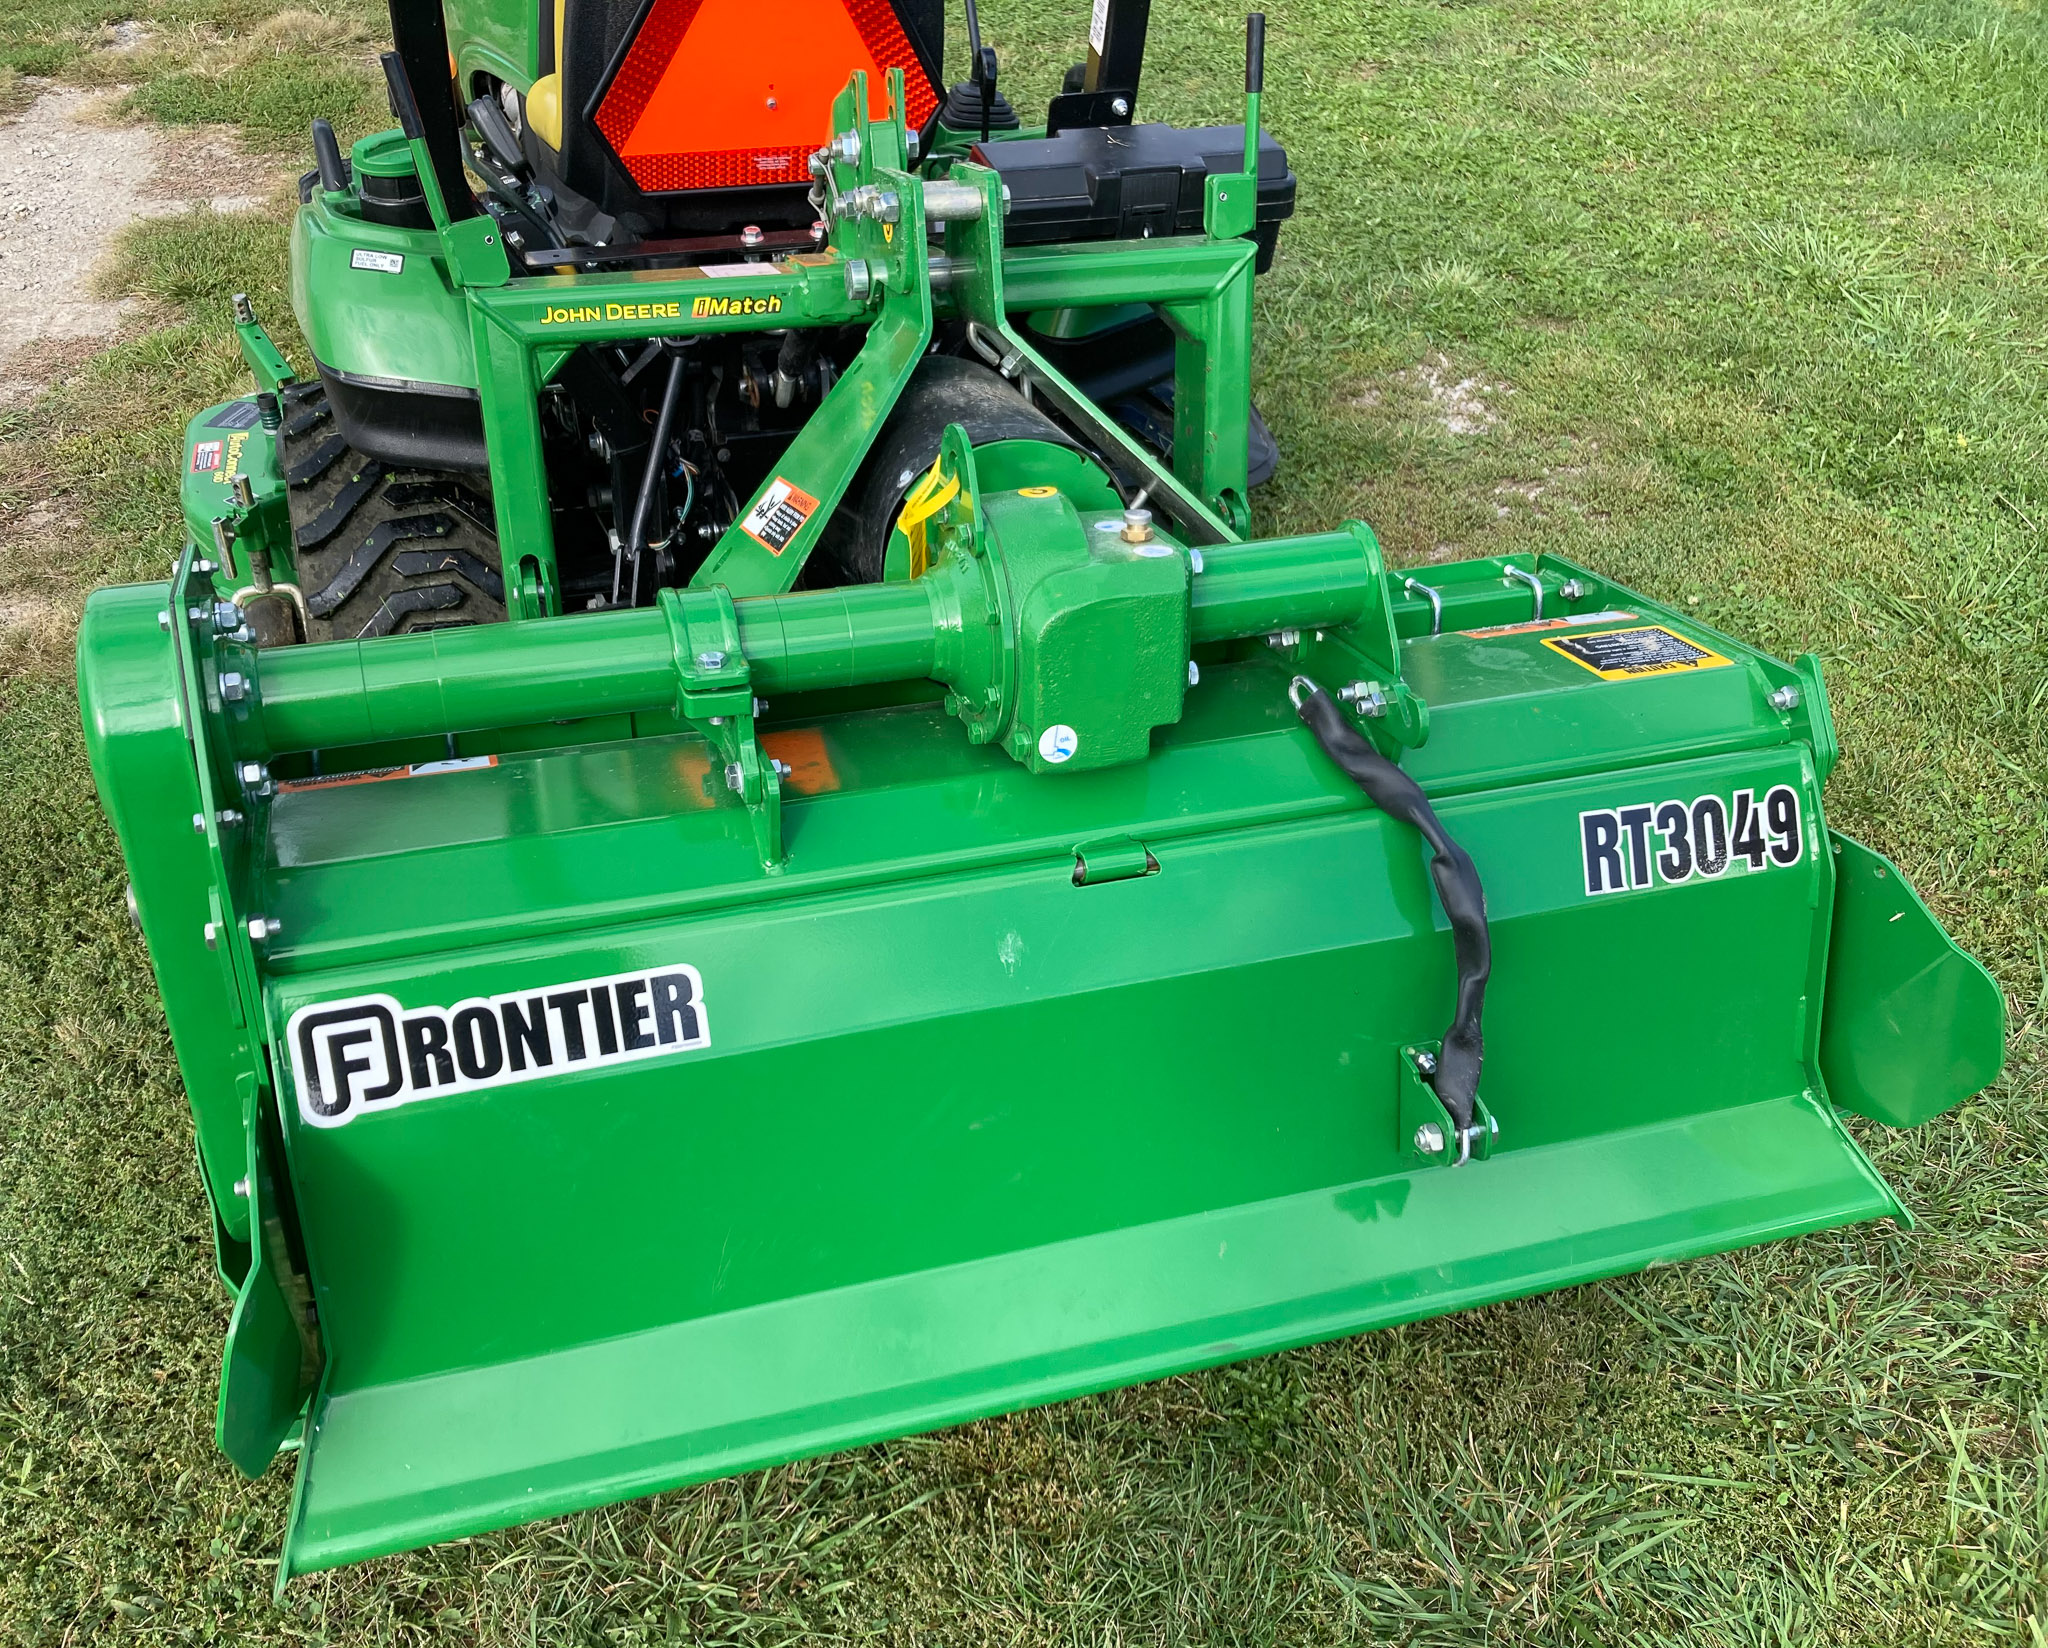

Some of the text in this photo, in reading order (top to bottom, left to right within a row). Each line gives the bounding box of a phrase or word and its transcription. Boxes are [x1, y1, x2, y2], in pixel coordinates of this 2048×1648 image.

[540, 306, 601, 325] JOHN
[605, 302, 681, 321] DEERE
[1623, 663, 1677, 675] CAUTION
[1583, 788, 1800, 893] RT3049
[297, 973, 701, 1117] FRONTIER
